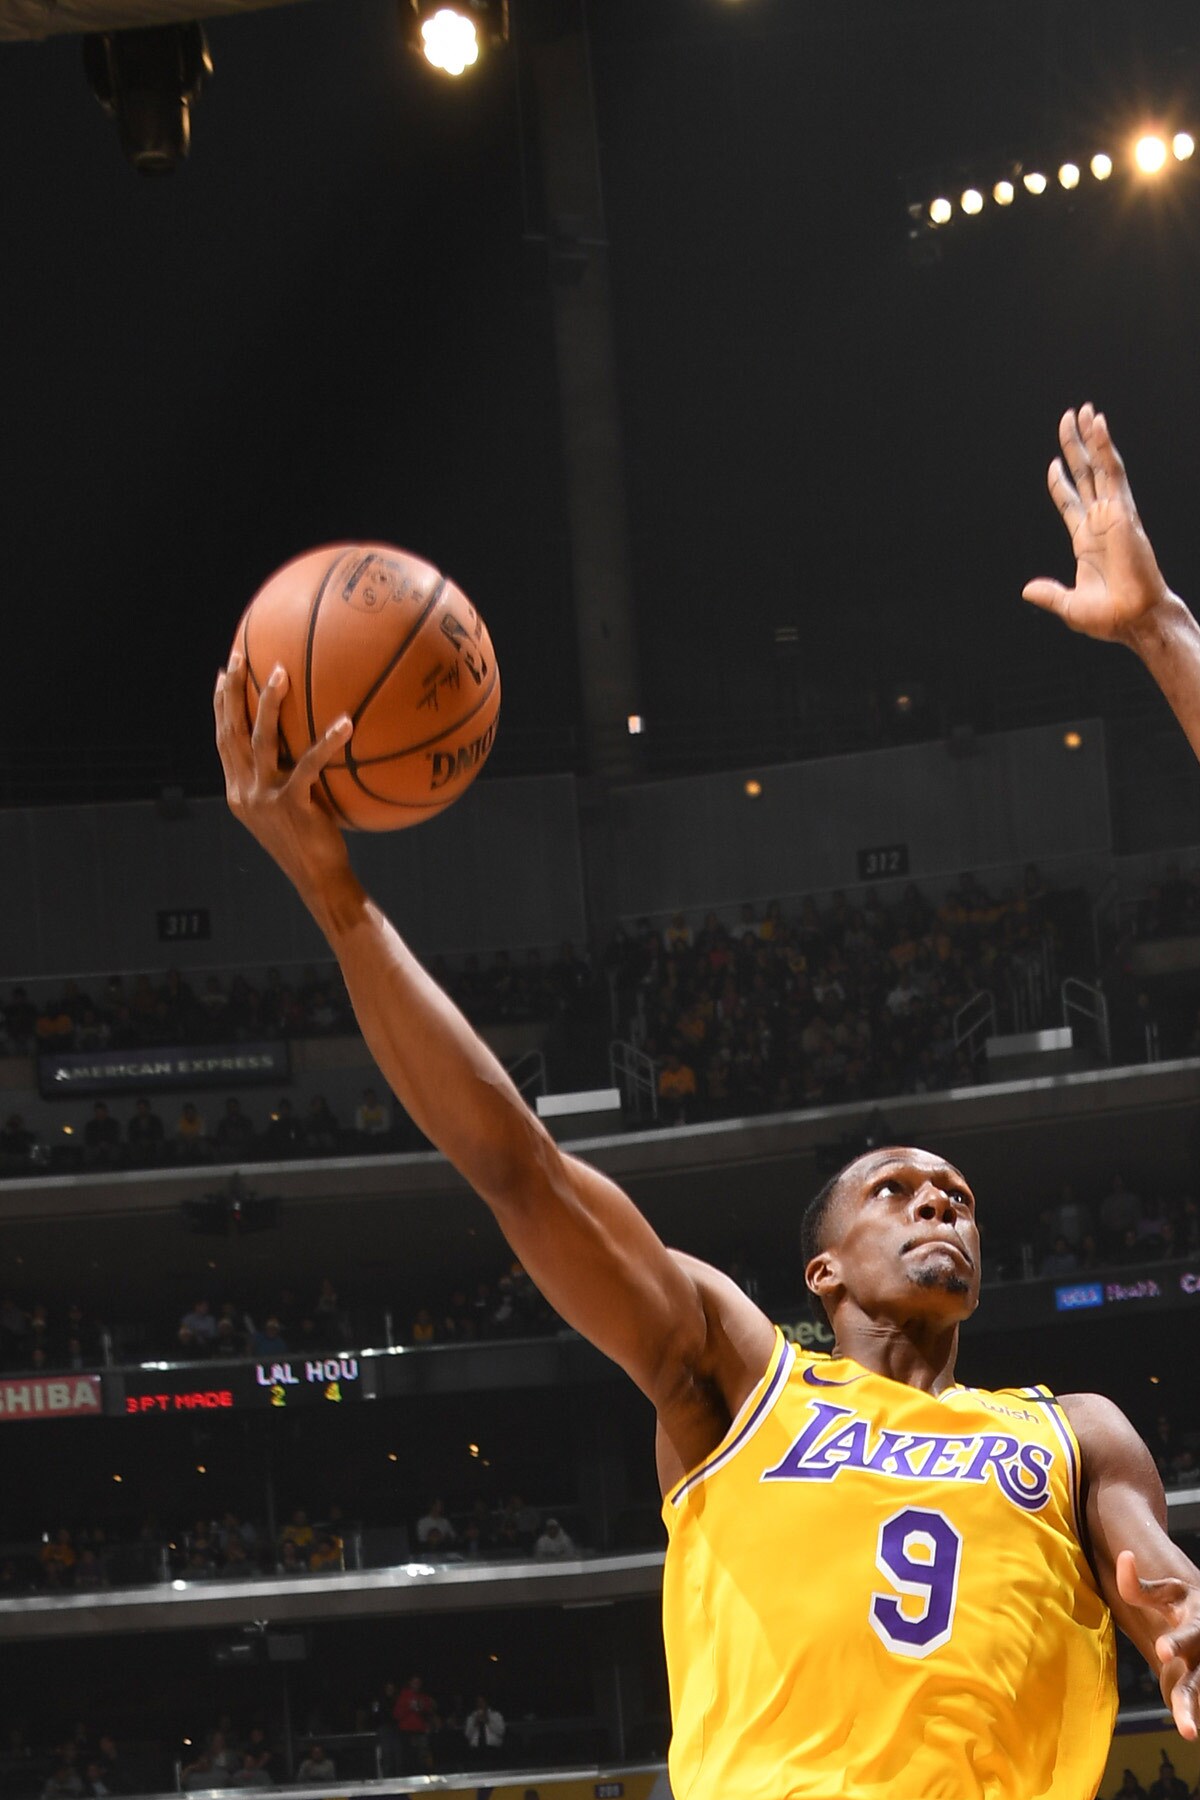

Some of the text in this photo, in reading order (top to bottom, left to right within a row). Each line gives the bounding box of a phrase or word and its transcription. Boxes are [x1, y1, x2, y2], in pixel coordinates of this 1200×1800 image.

[866, 851, 900, 874] 312
[166, 912, 200, 936] 311
[55, 1055, 273, 1082] AMERICAN EXPRESS
[256, 1360, 358, 1385] LAL HOU
[270, 1382, 342, 1408] 2 4
[973, 1398, 1040, 1424] wish
[759, 1398, 1054, 1513] LAKERS
[868, 1504, 963, 1660] 9
